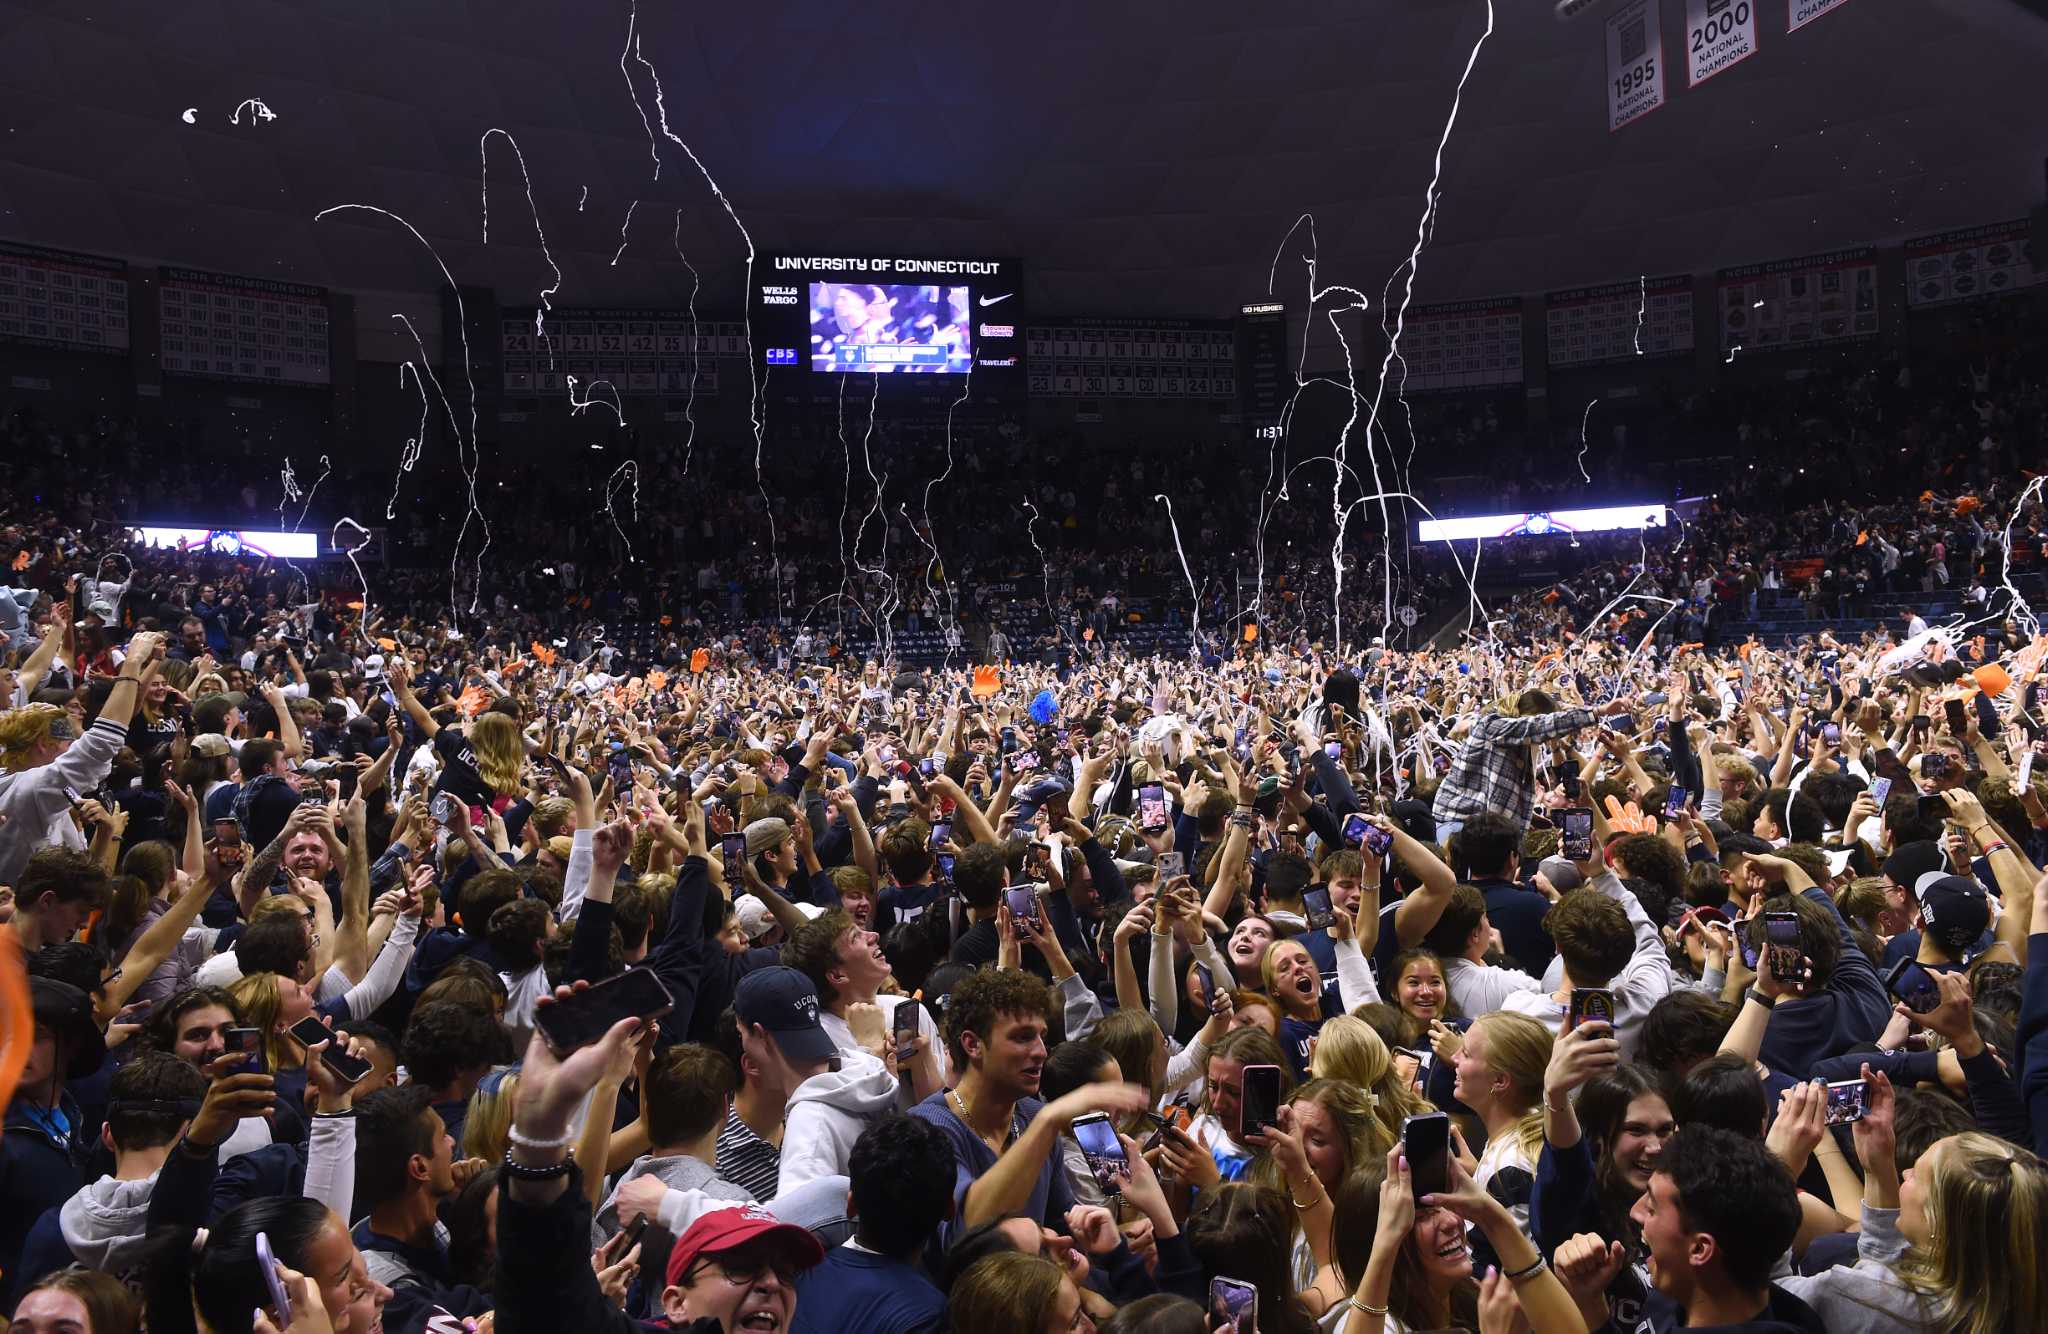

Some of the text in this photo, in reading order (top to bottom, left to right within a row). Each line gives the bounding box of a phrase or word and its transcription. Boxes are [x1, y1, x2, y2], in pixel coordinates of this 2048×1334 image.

[1691, 2, 1749, 53] 2000
[1699, 32, 1744, 64] NATIONAL
[1696, 45, 1749, 79] CHAMPIONS
[1614, 59, 1655, 98] 1995
[1615, 96, 1658, 126] CHAMPIONS
[1617, 86, 1655, 112] NATIONAL
[775, 257, 1000, 274] UNIVERSITY OF CONNECTICUT
[762, 286, 798, 295] WELLS
[763, 296, 798, 305] FARGO
[506, 336, 528, 350] 24
[602, 336, 621, 350] 52
[631, 336, 653, 350] 42
[1255, 426, 1283, 438] 11:37
